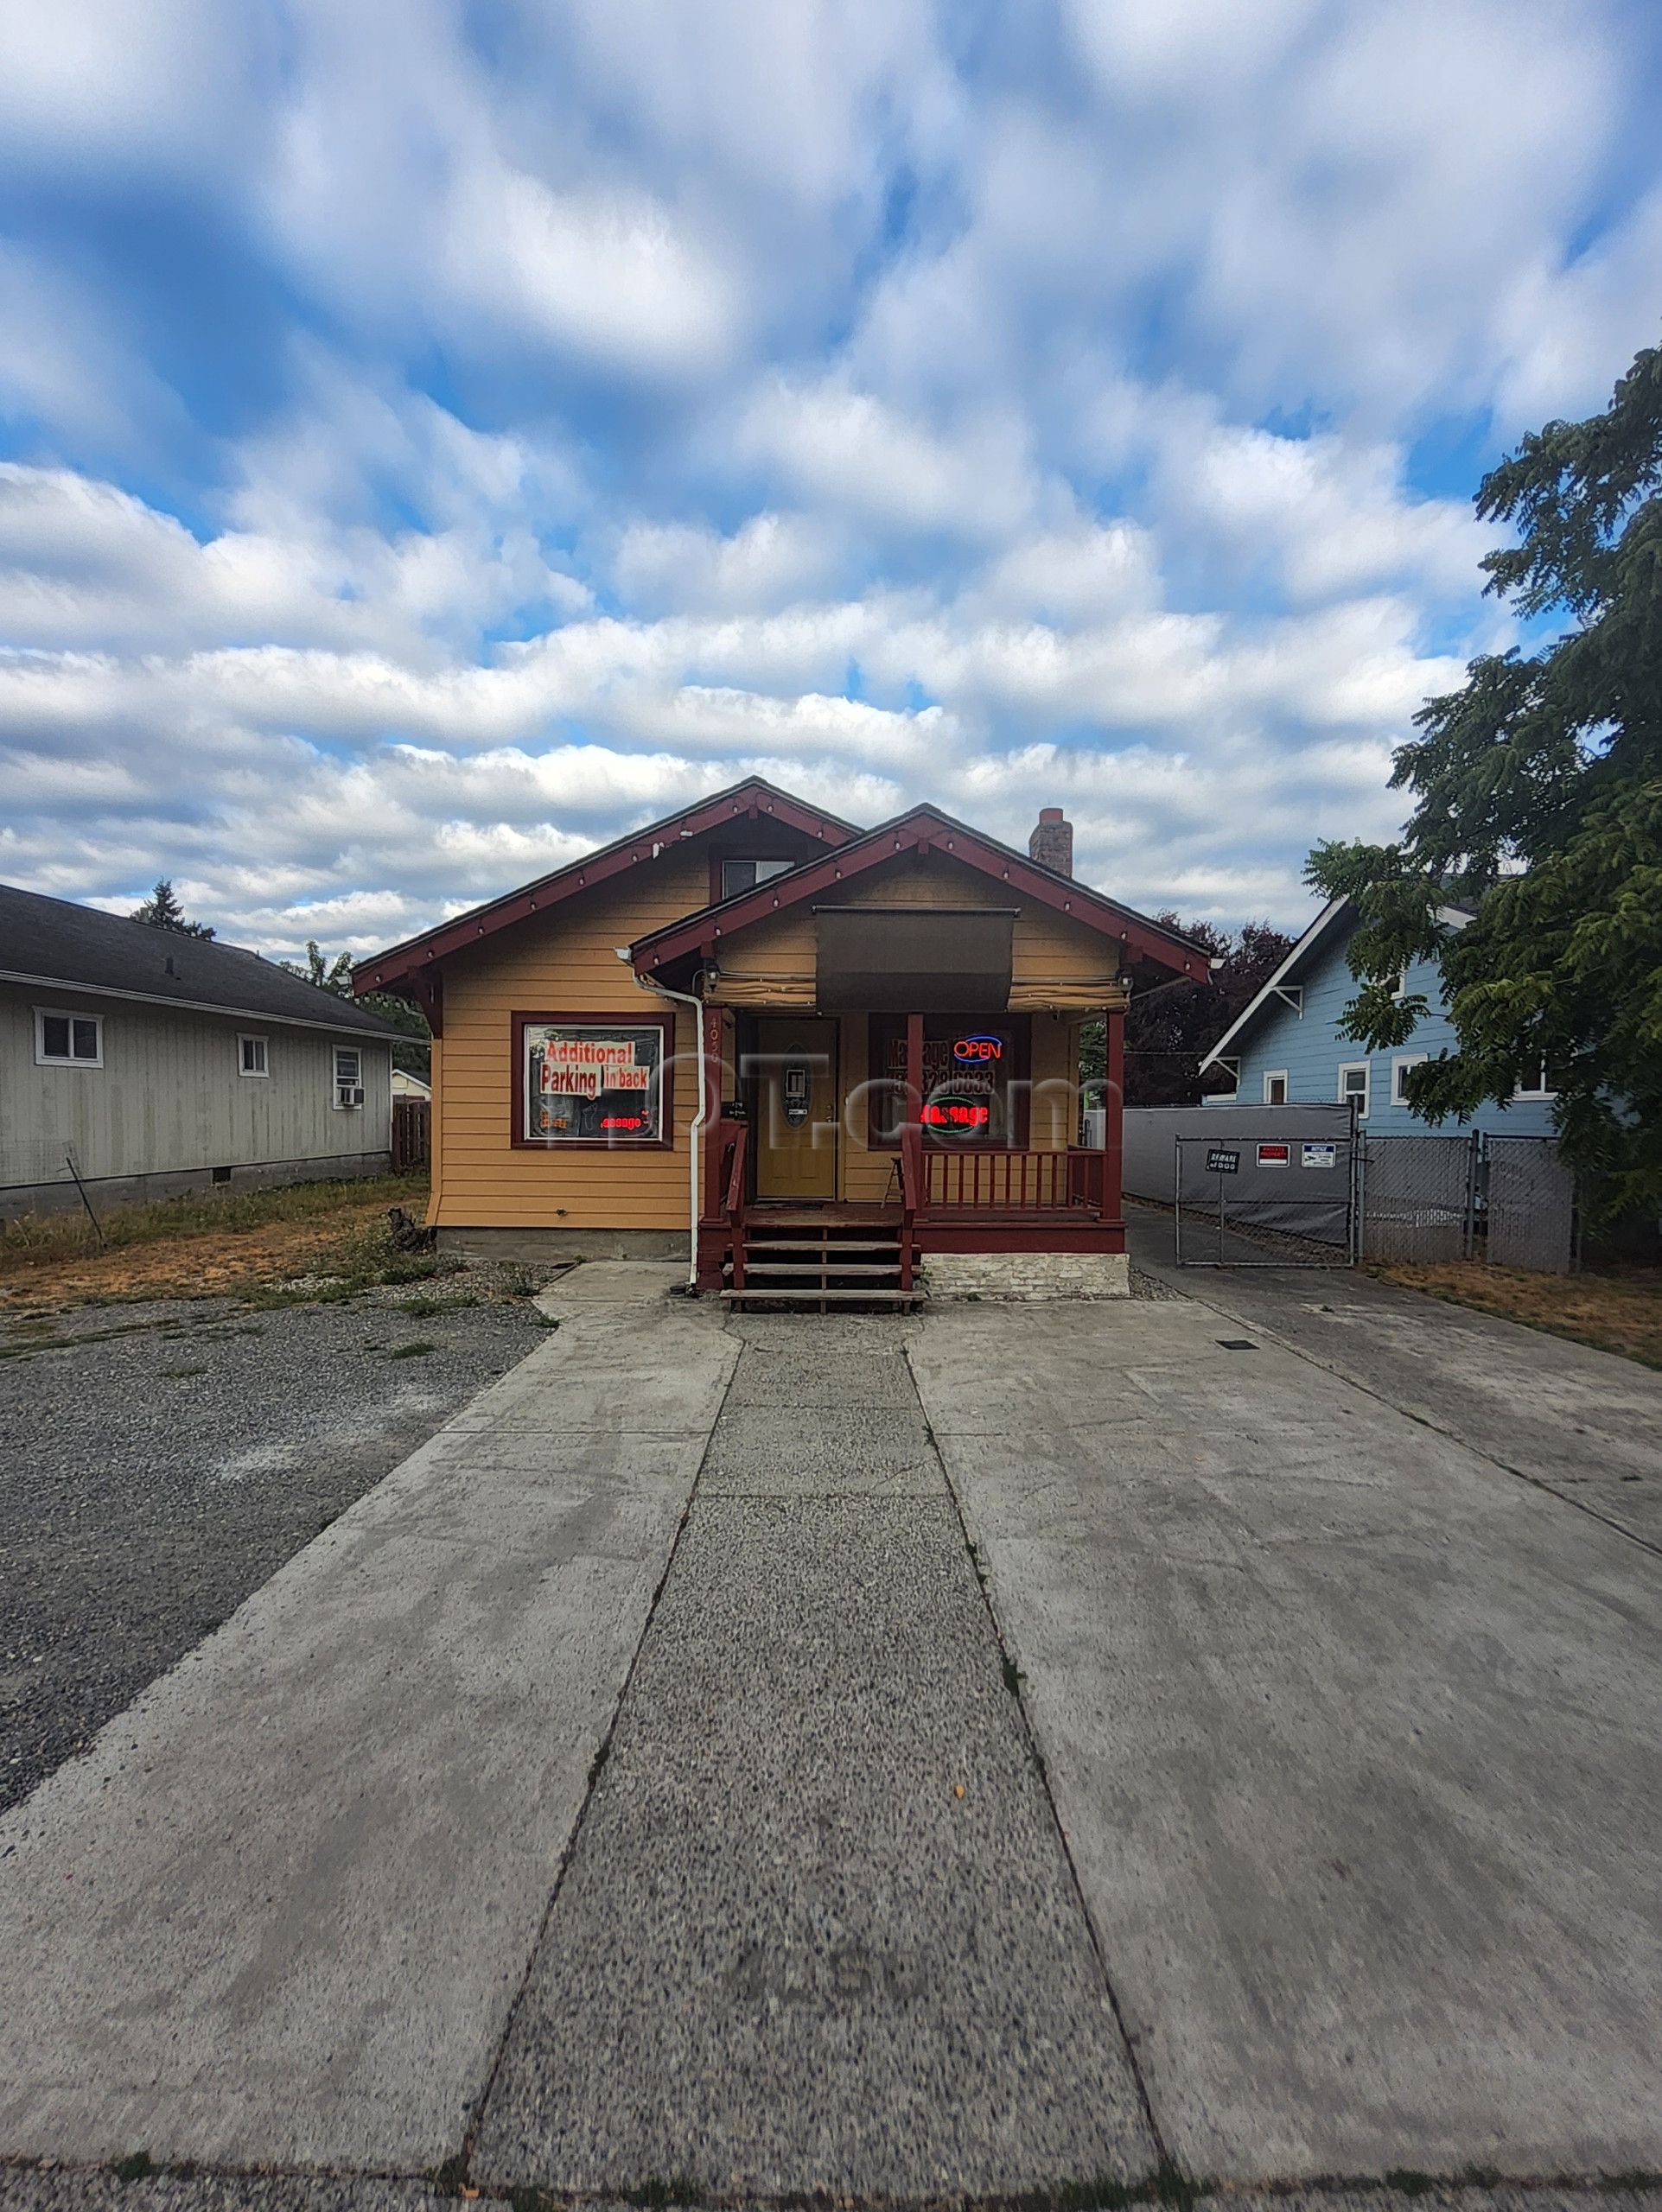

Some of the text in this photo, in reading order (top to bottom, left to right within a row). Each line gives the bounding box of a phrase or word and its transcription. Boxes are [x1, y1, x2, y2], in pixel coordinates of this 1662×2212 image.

[547, 1040, 632, 1064] Additional
[888, 1039, 948, 1069] Maage
[953, 1040, 1003, 1059] OPEN
[542, 1065, 647, 1099] Parking in back
[600, 1117, 641, 1130] assage
